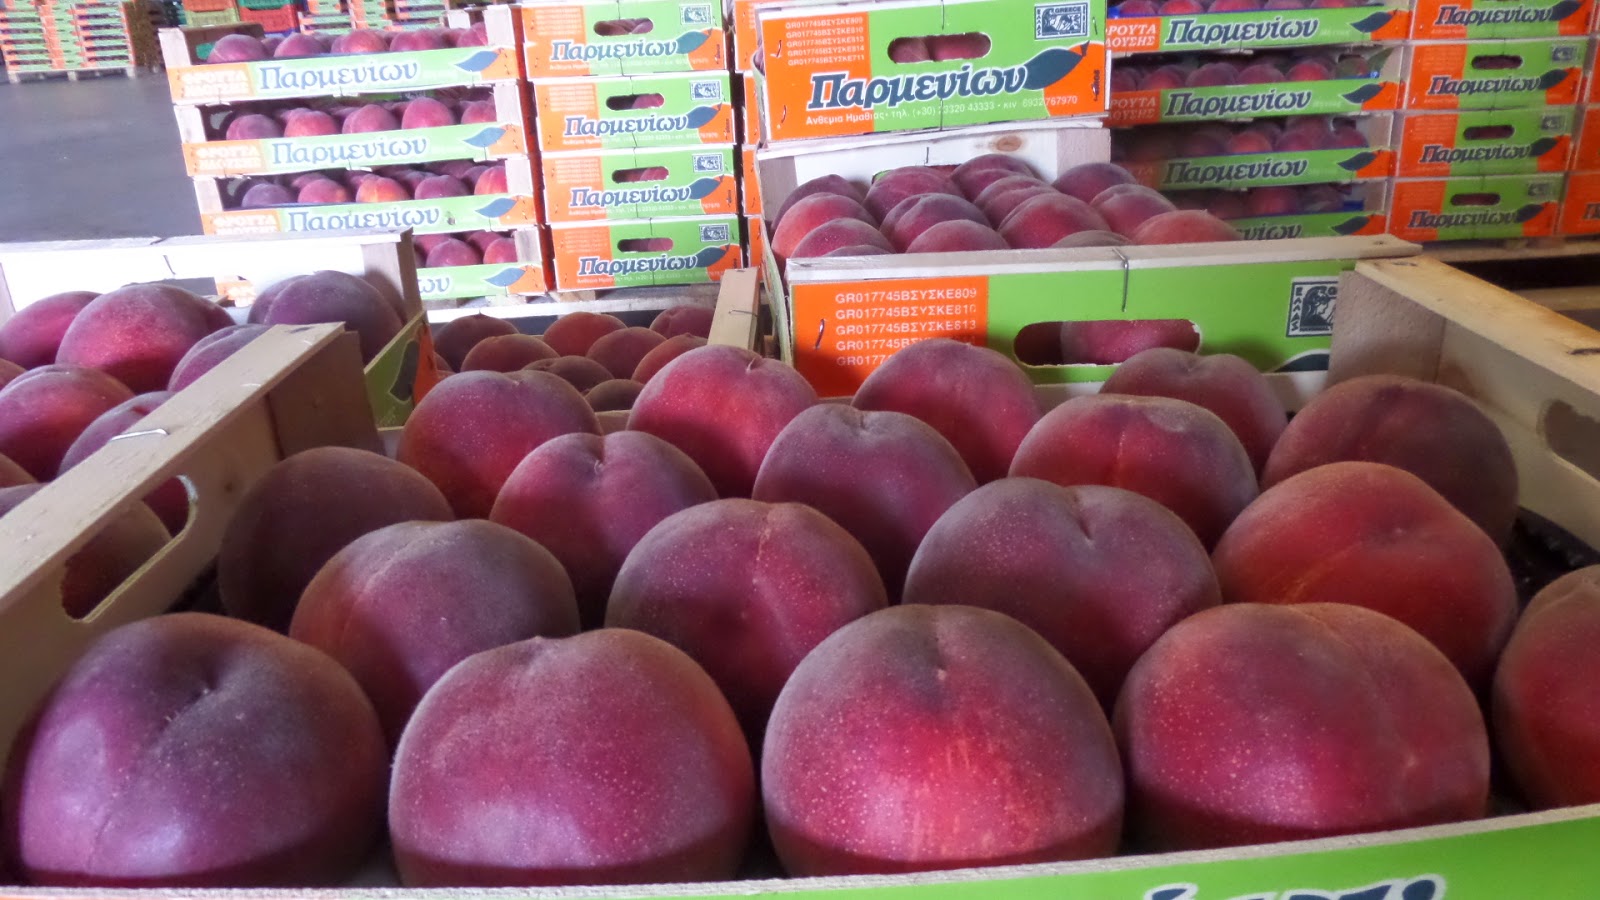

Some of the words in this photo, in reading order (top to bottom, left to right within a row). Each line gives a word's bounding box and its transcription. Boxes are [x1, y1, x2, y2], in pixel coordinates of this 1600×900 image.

[1106, 24, 1156, 35] ΡΟΥΤΑ
[1165, 16, 1318, 45] Παρμενίων
[550, 38, 677, 61] Παρμενίων
[1106, 36, 1155, 47] ΑΟΥΣΗΣ
[260, 60, 418, 90] Παρμενίων
[807, 64, 1027, 109] Παρμενίων
[1111, 96, 1156, 108] ΡΟΥΤΑ
[1164, 89, 1312, 116] Παρμενίων
[564, 114, 688, 136] Παρμενίων
[272, 137, 427, 165] Παρμενίων
[1163, 158, 1308, 184] Παρμενίων
[569, 185, 691, 207] Παρμενίων
[578, 254, 698, 275] Παρμενίων
[835, 288, 977, 304] GR017745ΒΣΥΣΚΕ809
[835, 304, 976, 320] GR017745ΒΣΥΣΚΕ810
[836, 320, 977, 335] GR017745ΒΣΥΣΚΕ813
